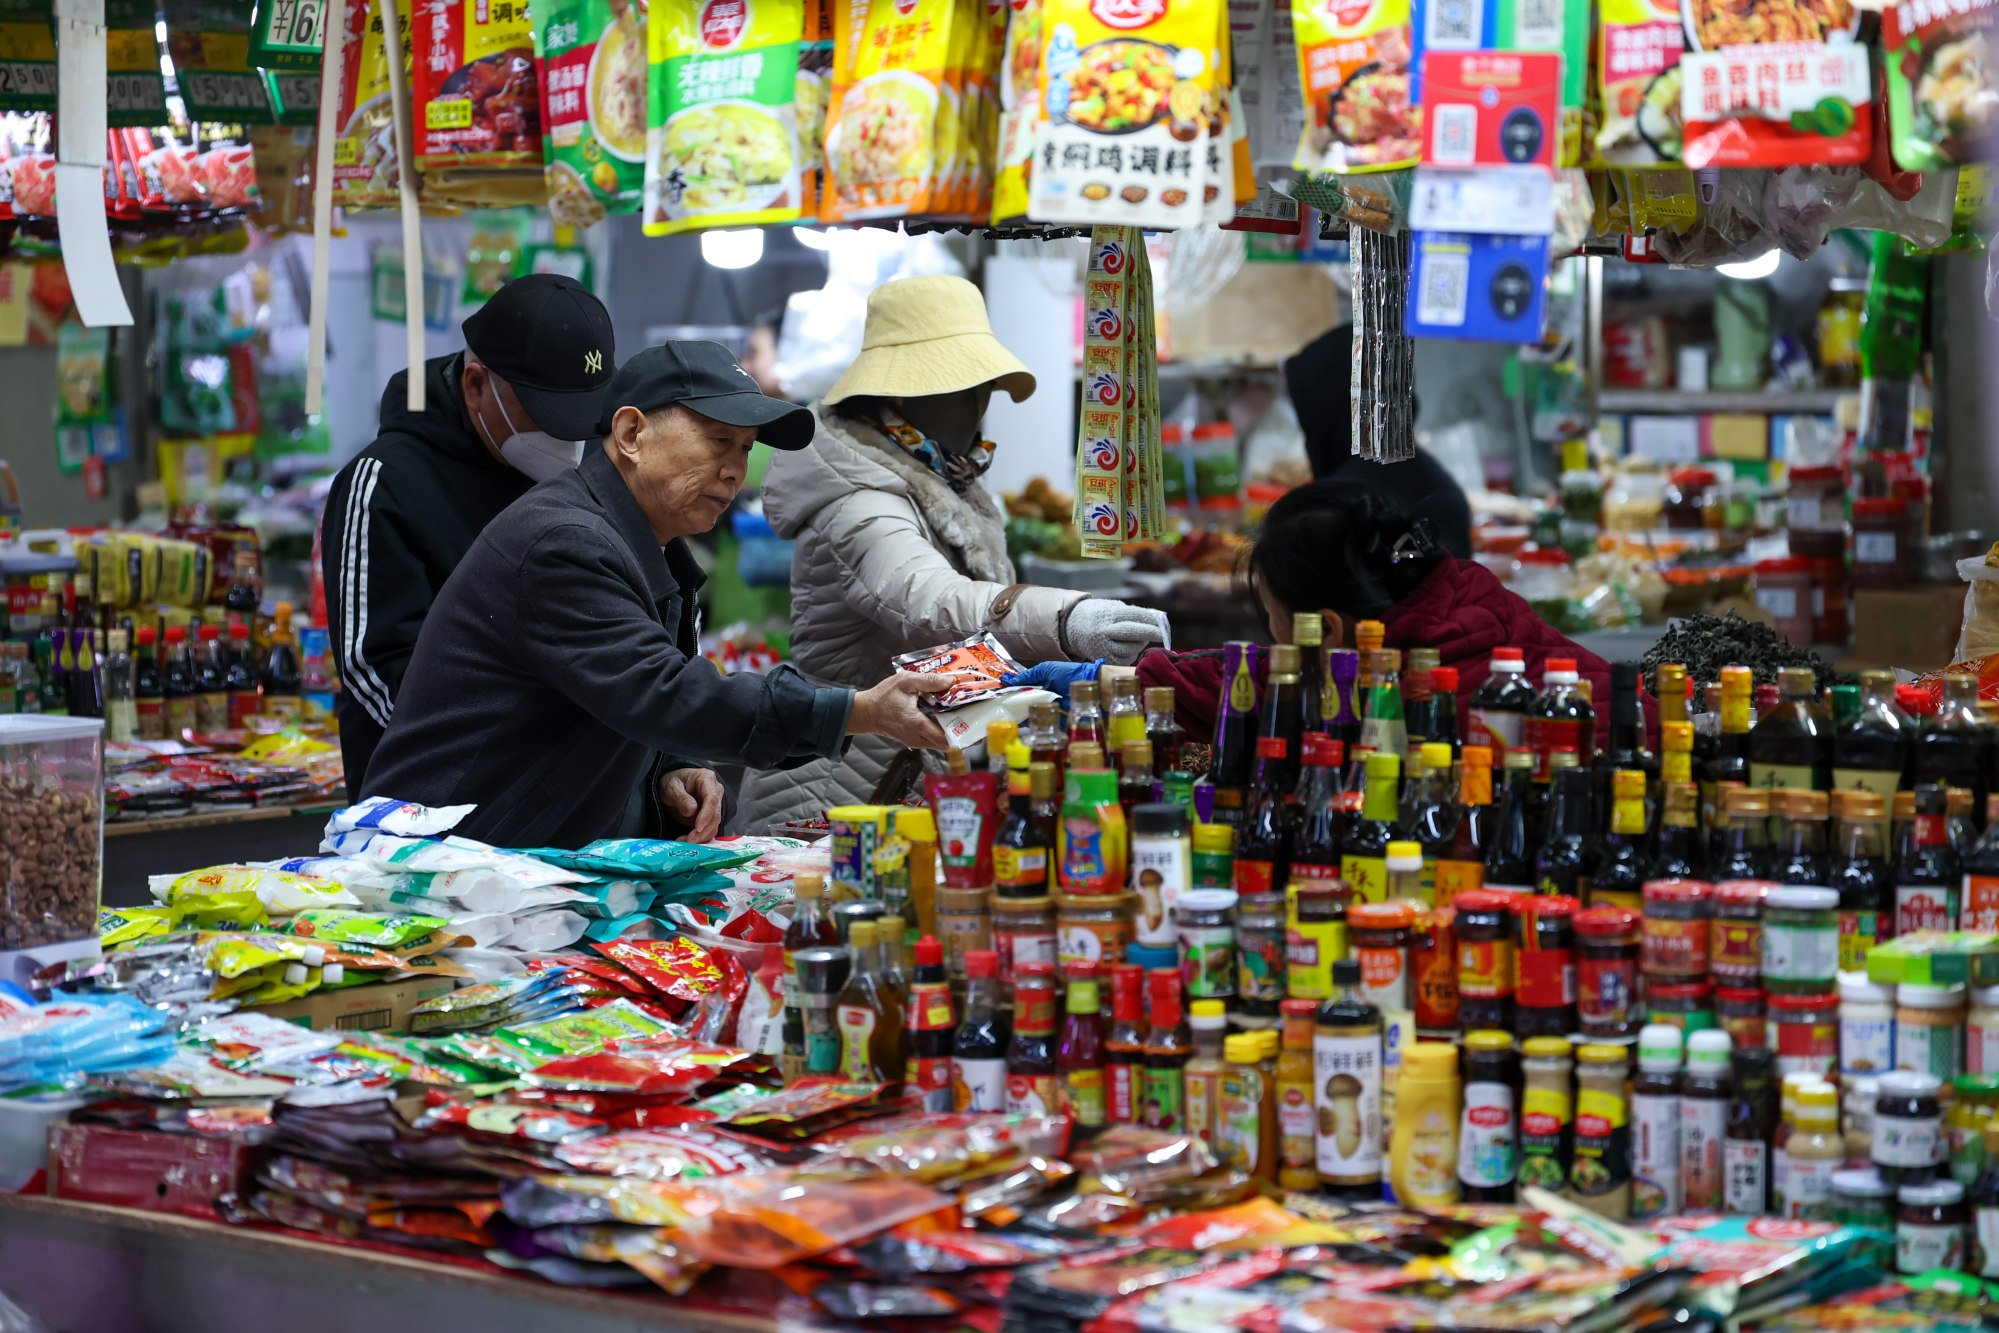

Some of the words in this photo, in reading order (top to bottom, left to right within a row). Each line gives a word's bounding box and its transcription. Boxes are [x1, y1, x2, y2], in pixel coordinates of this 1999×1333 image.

[1702, 61, 1808, 87] 鱼香肉丝
[584, 349, 602, 374] NY
[1108, 413, 1119, 439] Angel
[1107, 479, 1117, 504] Angel
